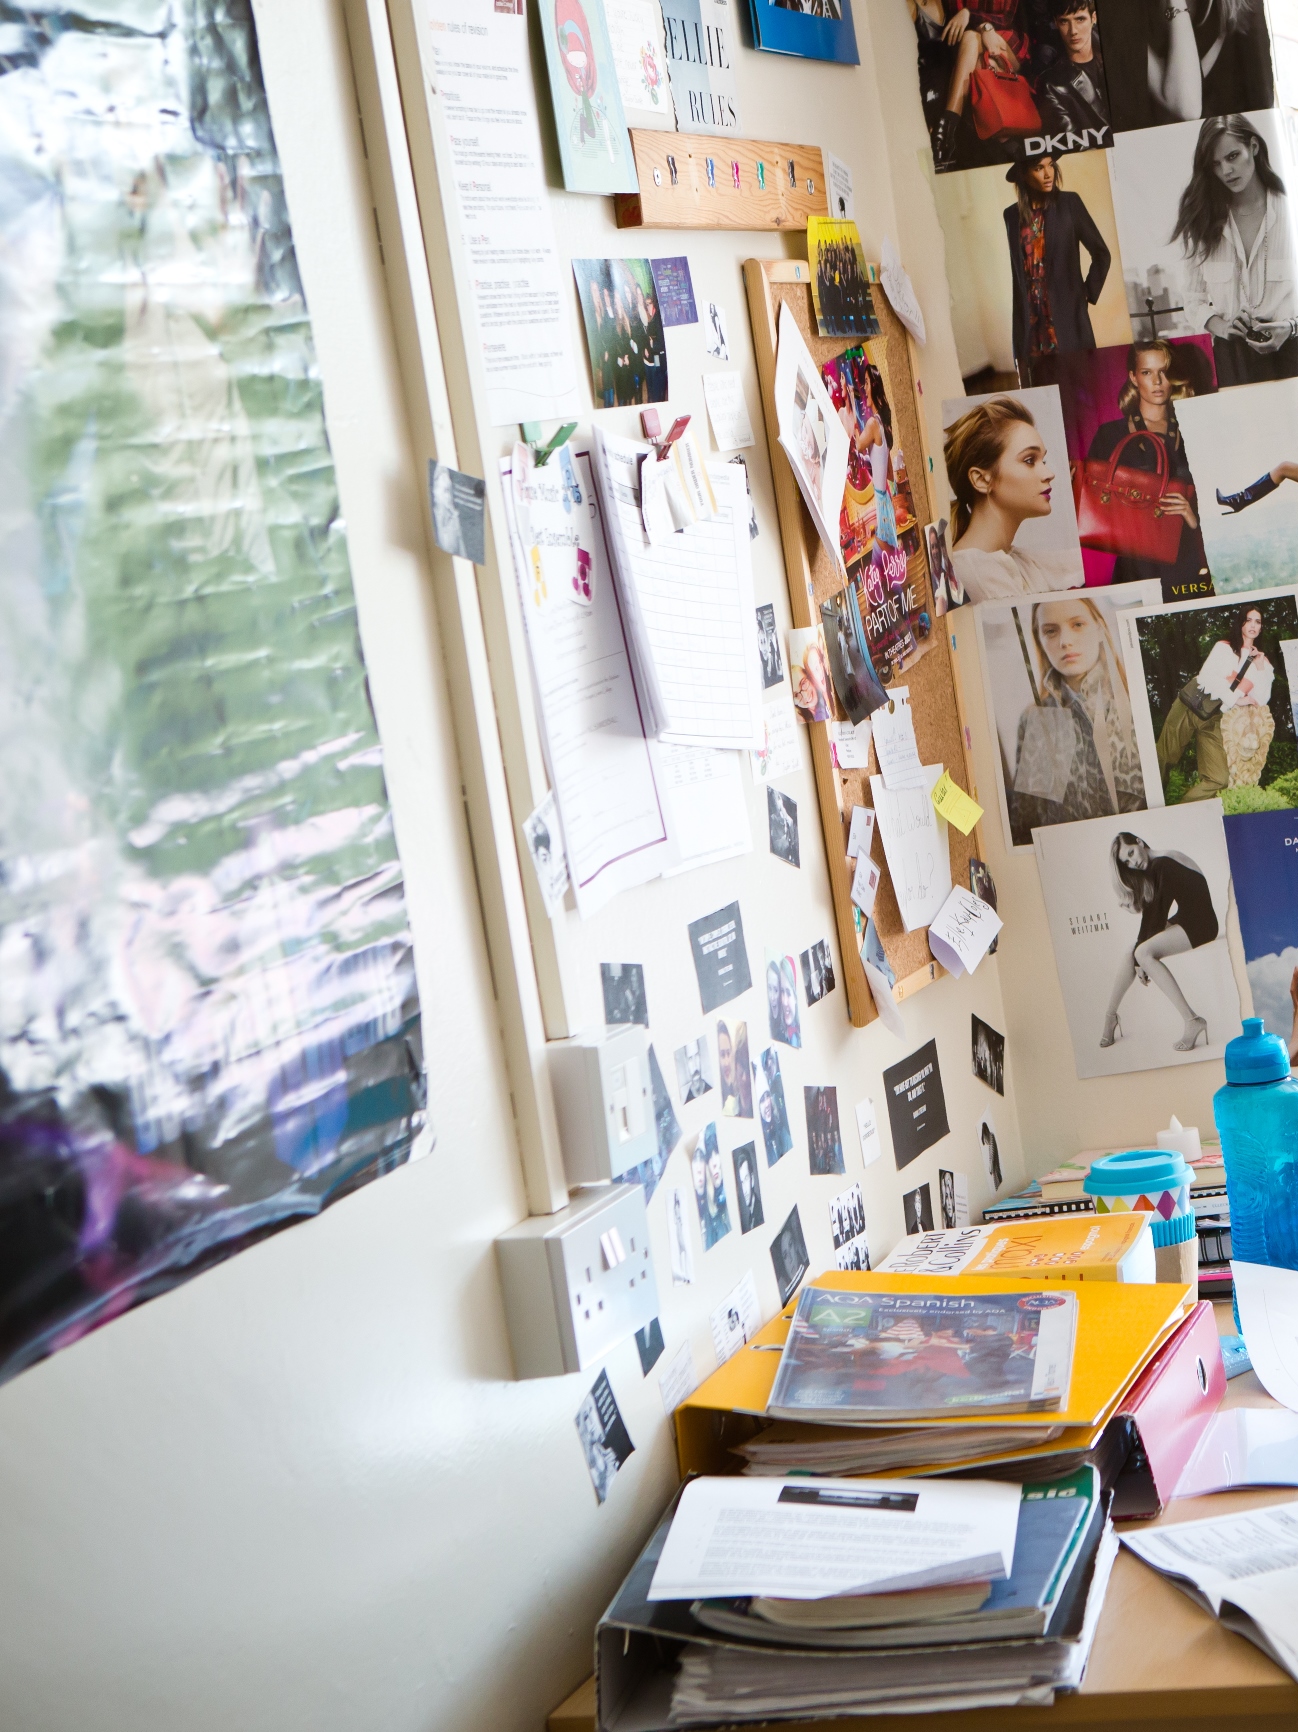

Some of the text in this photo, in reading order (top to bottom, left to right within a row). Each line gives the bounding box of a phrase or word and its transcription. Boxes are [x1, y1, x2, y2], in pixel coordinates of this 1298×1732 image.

[666, 17, 730, 69] ELLIE
[688, 90, 737, 128] RULES
[1023, 125, 1110, 157] DKNY
[859, 550, 907, 609] Katy Perry
[865, 603, 892, 640] PART
[900, 584, 918, 615] ME
[1068, 912, 1107, 926] STUART
[1070, 922, 1110, 936] WEITZMAN
[815, 1292, 975, 1309] AQA Spanish
[812, 1307, 868, 1325] A2
[1022, 1487, 1078, 1501] sic
